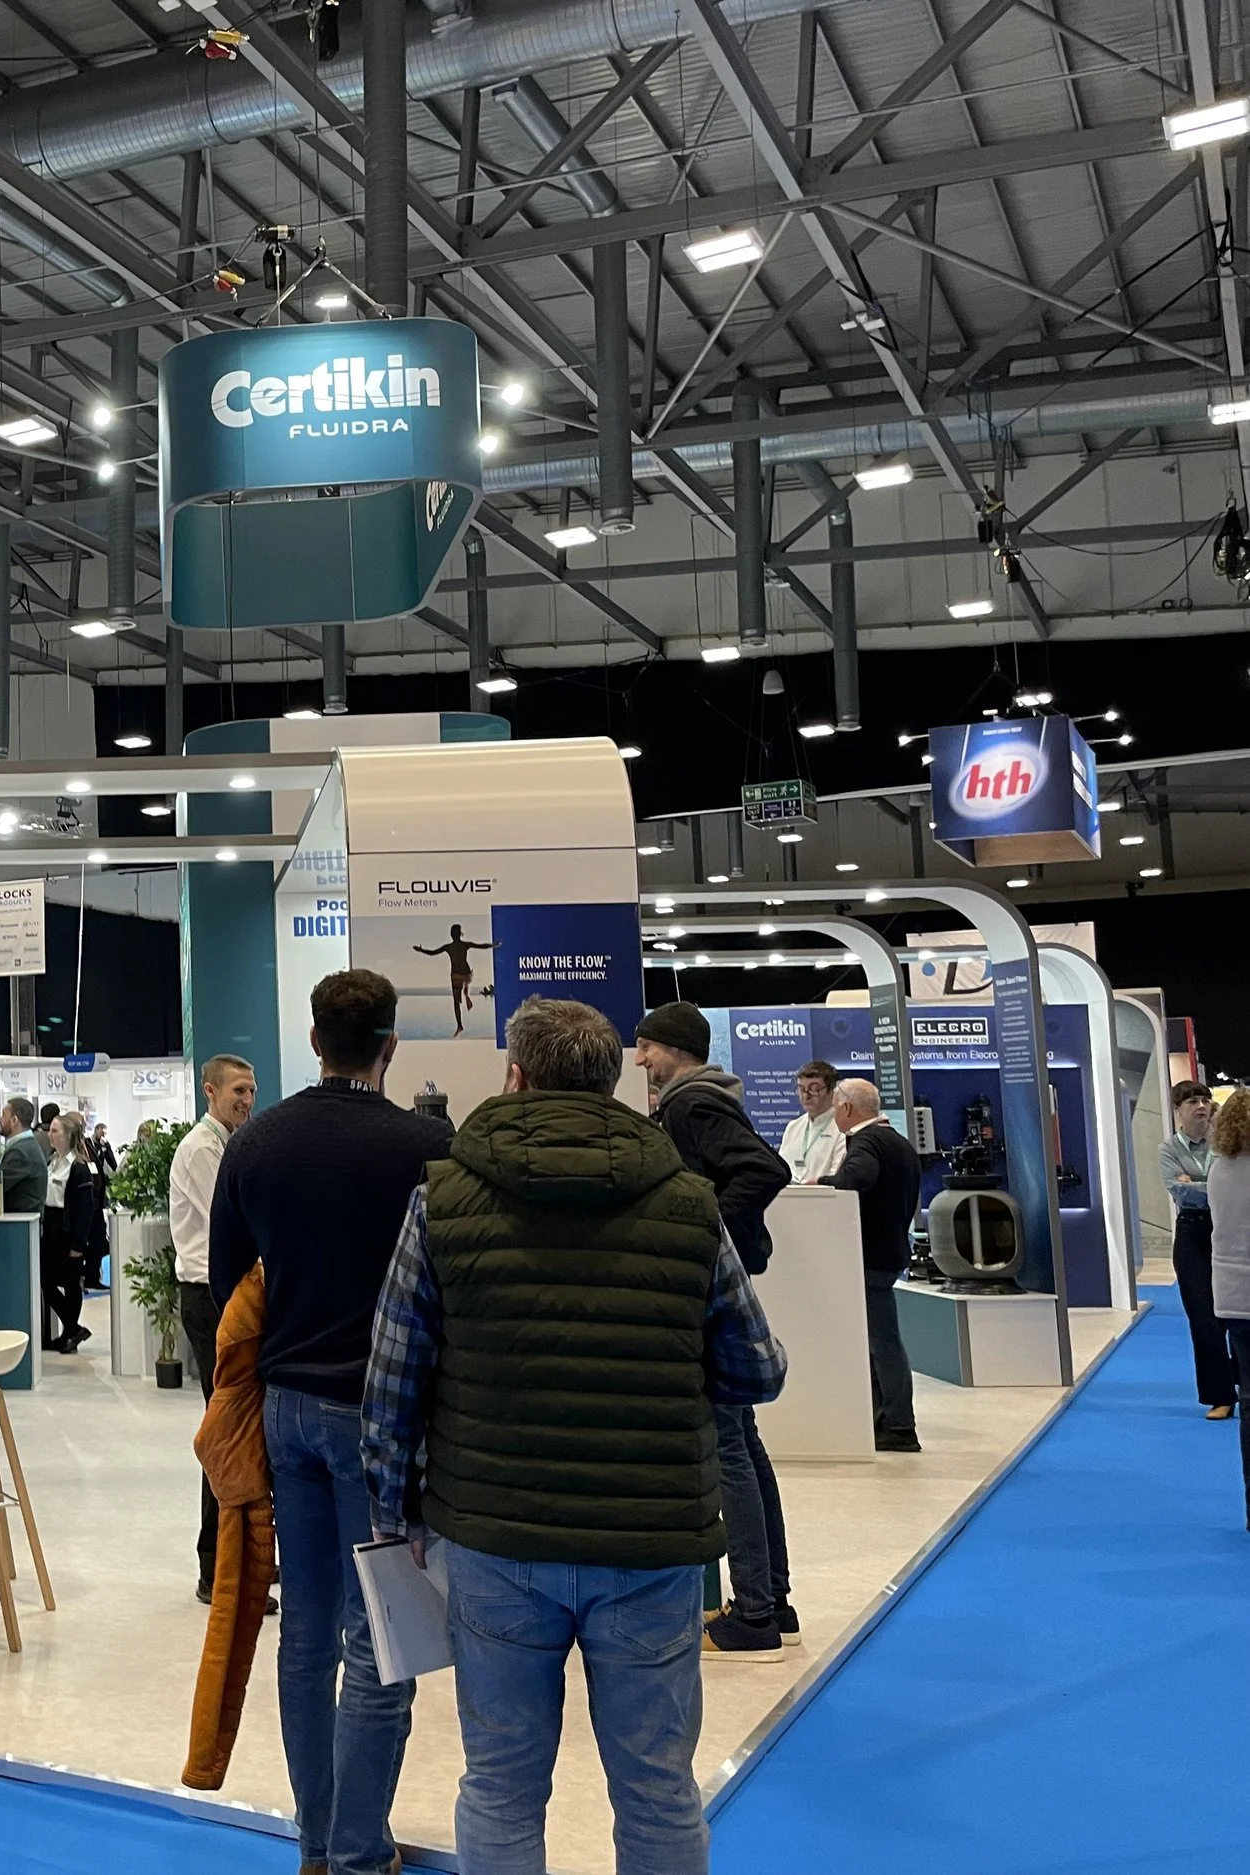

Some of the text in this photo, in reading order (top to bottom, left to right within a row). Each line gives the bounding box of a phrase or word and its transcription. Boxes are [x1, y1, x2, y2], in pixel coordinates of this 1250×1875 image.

[211, 354, 441, 428] Certikin
[289, 418, 410, 439] FLUIDRA
[966, 761, 1032, 800] hth
[378, 898, 438, 908] Flow Meters
[519, 956, 551, 969] KNOW
[552, 955, 573, 968] THE
[519, 970, 608, 981] MAXIMIZE THE EFFICIENCY.
[735, 1019, 806, 1040] Certikin
[914, 1036, 989, 1045] ENGINEERING
[946, 1050, 968, 1060] from
[970, 1051, 998, 1060] Elecro
[47, 1073, 67, 1090] SCP
